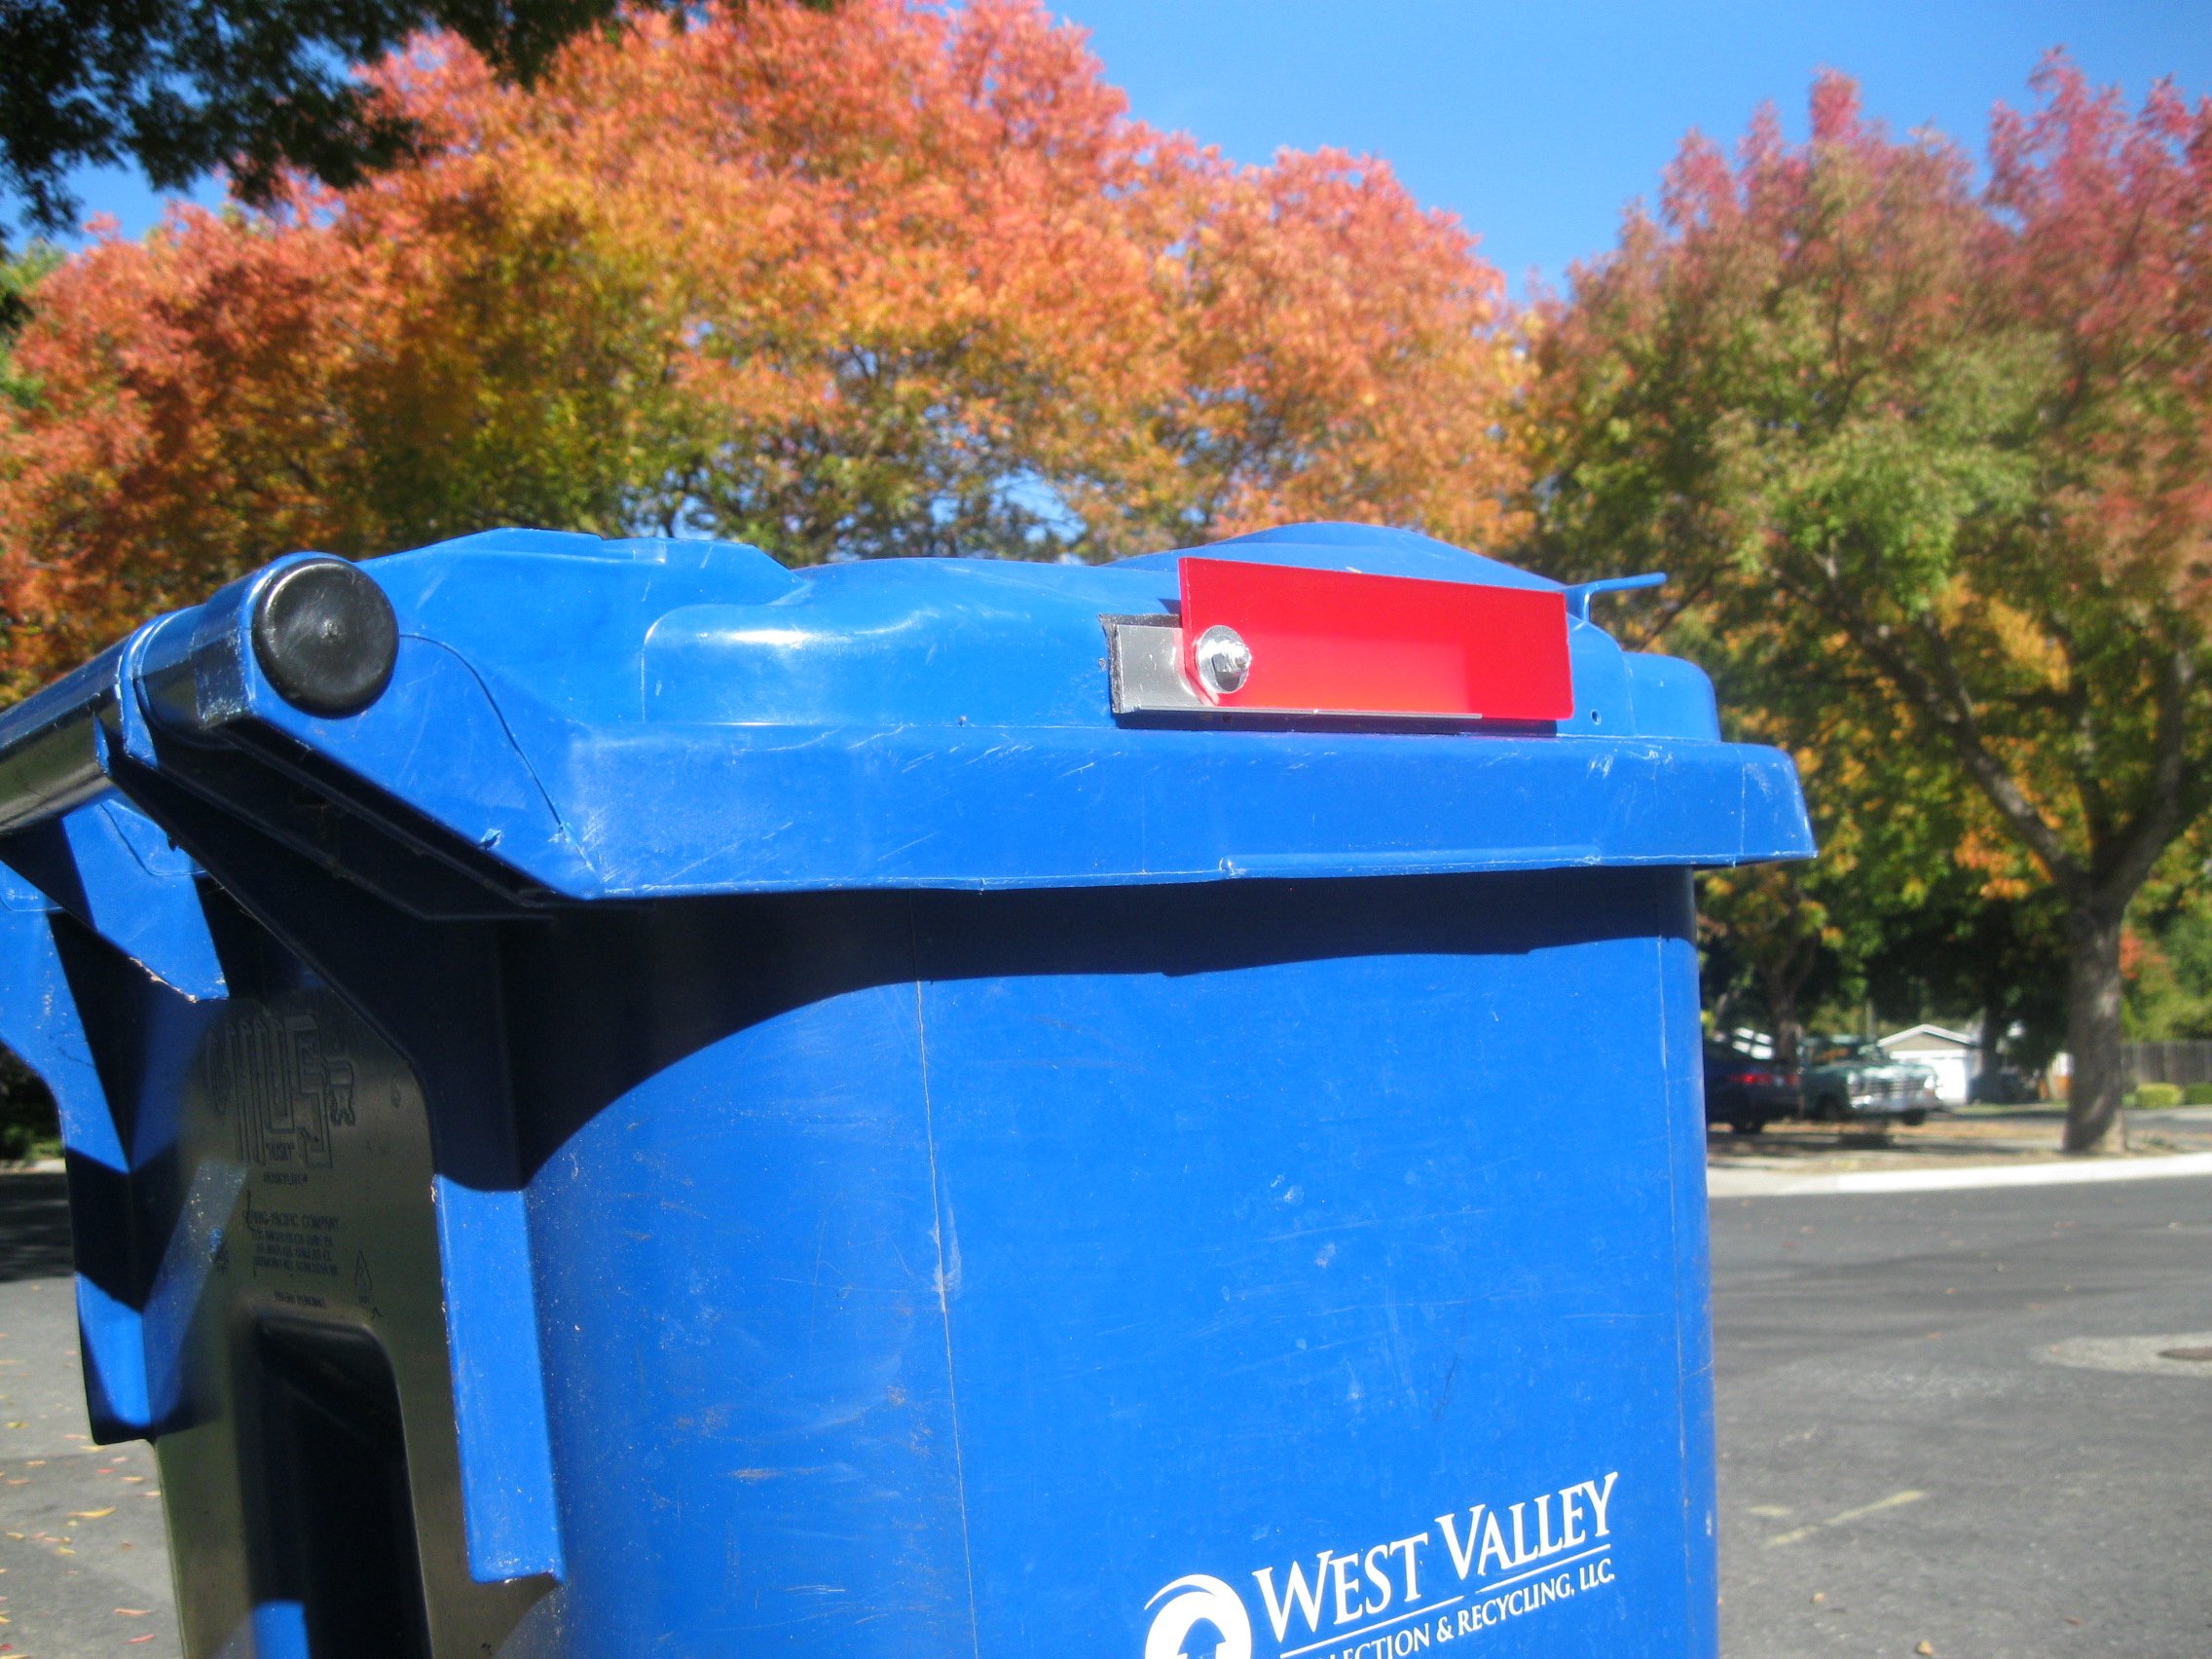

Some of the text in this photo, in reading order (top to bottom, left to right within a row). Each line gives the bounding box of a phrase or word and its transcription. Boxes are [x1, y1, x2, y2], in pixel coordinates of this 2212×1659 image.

[1251, 1471, 1619, 1643] WEST VALLEY
[1436, 1616, 1455, 1643] &
[1456, 1573, 1575, 1637] RECYCLING,
